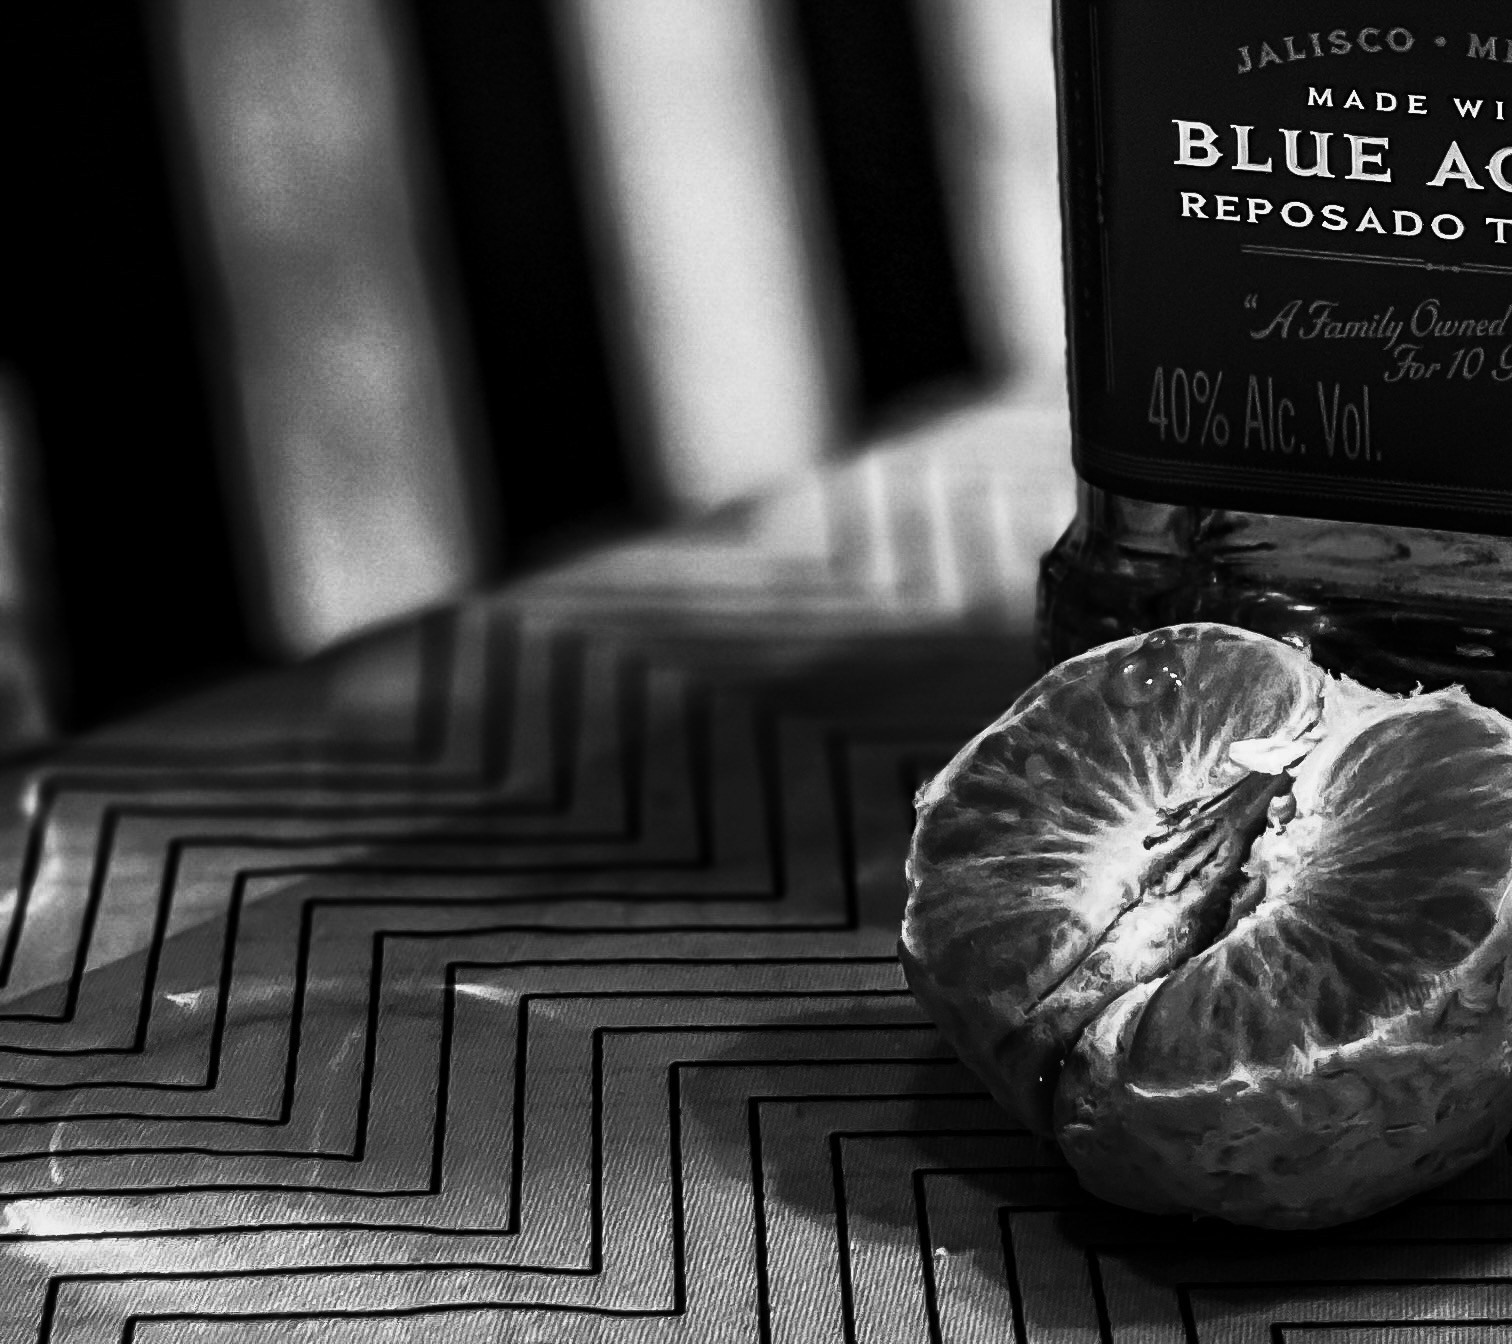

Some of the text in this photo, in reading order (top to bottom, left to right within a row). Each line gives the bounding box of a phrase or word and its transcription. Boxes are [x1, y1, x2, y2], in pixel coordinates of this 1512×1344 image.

[1236, 26, 1416, 75] JALISCO
[1306, 86, 1429, 116] MADE
[1172, 118, 1394, 184] BLUE
[1179, 190, 1466, 241] REPOSADO
[1299, 299, 1404, 351] Family
[1384, 343, 1441, 383] For
[1446, 346, 1485, 381] 10
[1148, 366, 1382, 461] 40% Alc. Vol.
